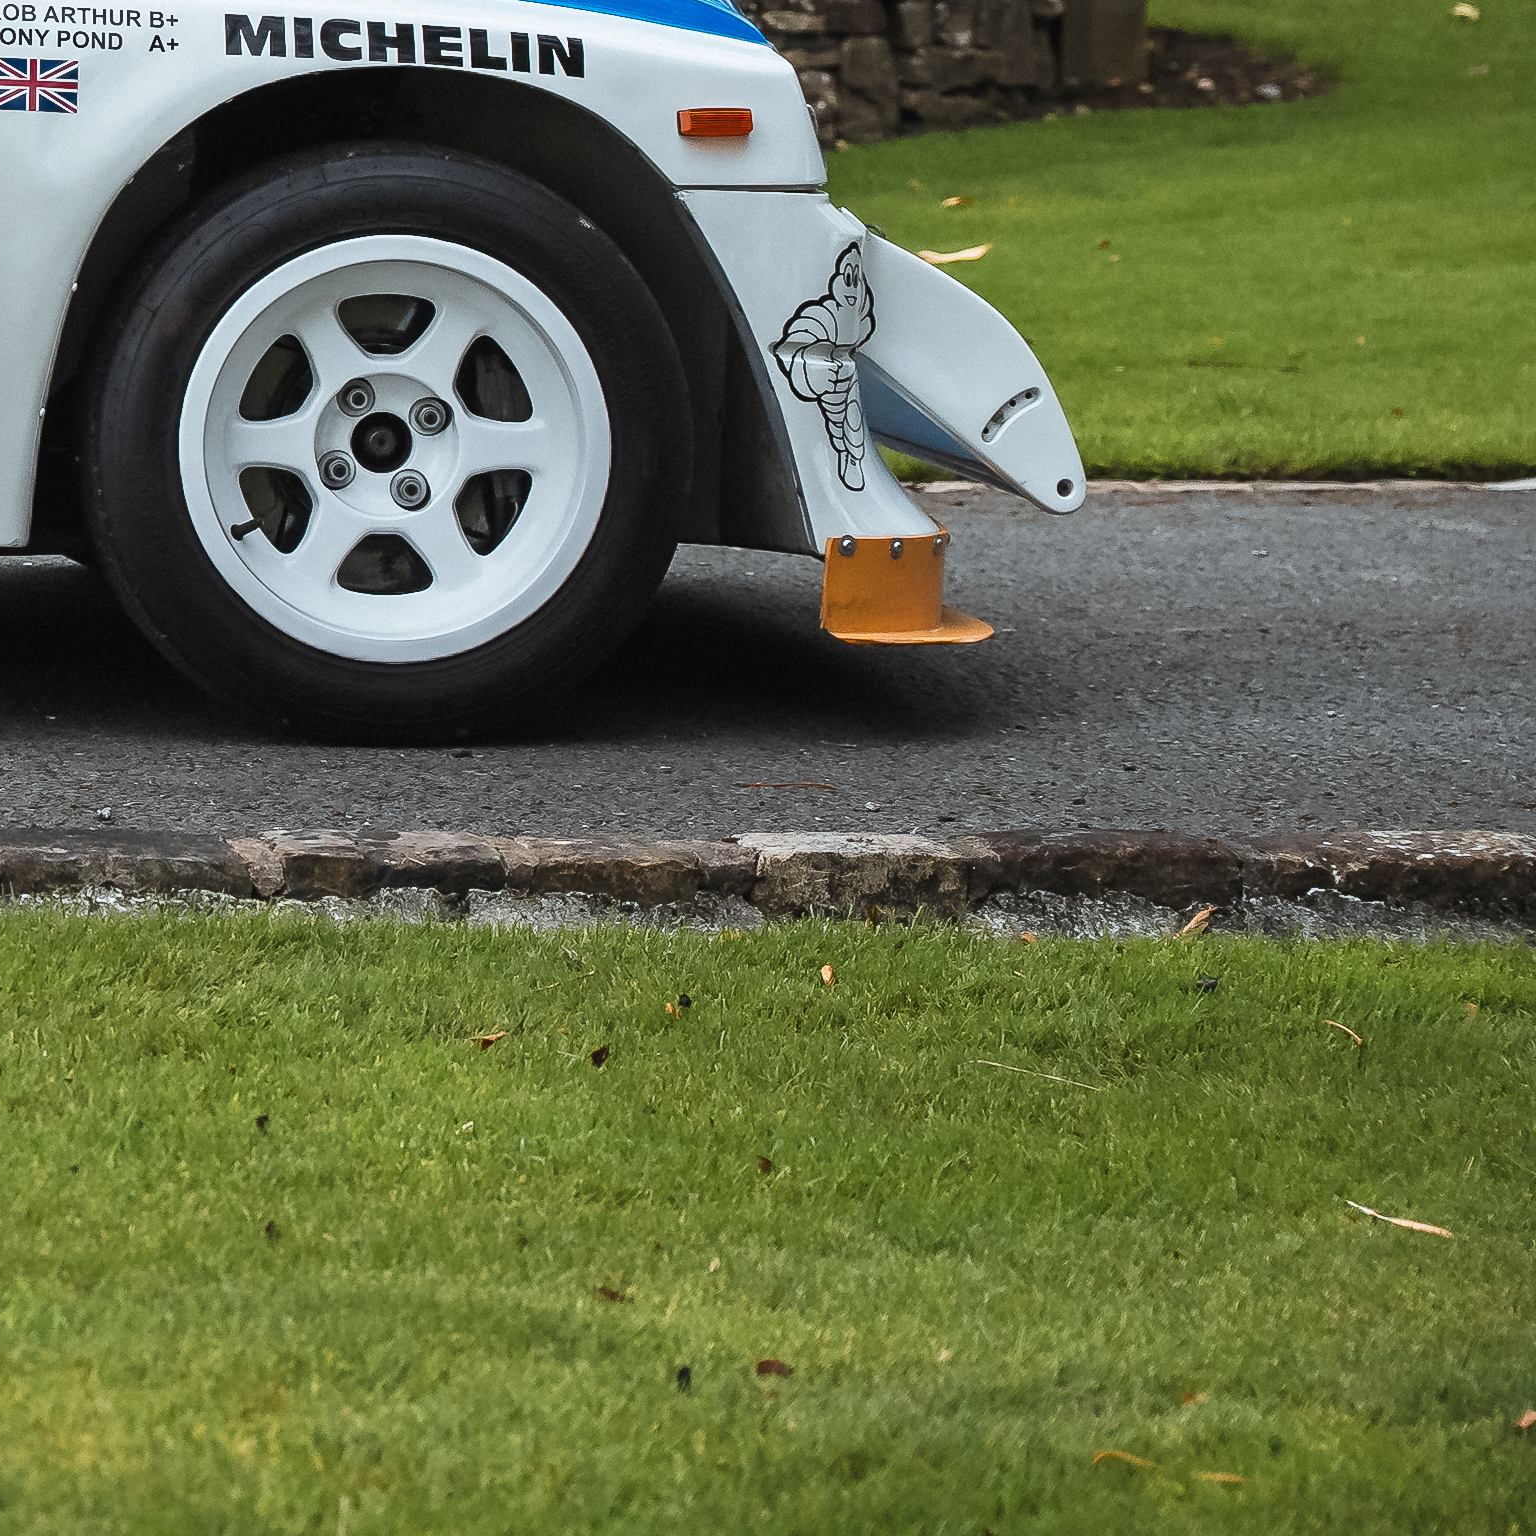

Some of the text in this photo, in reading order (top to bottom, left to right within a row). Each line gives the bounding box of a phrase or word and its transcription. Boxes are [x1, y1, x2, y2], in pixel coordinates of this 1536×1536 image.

[43, 5, 142, 27] ARTHUR
[149, 10, 179, 28] B+
[57, 30, 123, 50] POND
[148, 34, 179, 52] A+
[224, 13, 585, 78] MICHELIN
